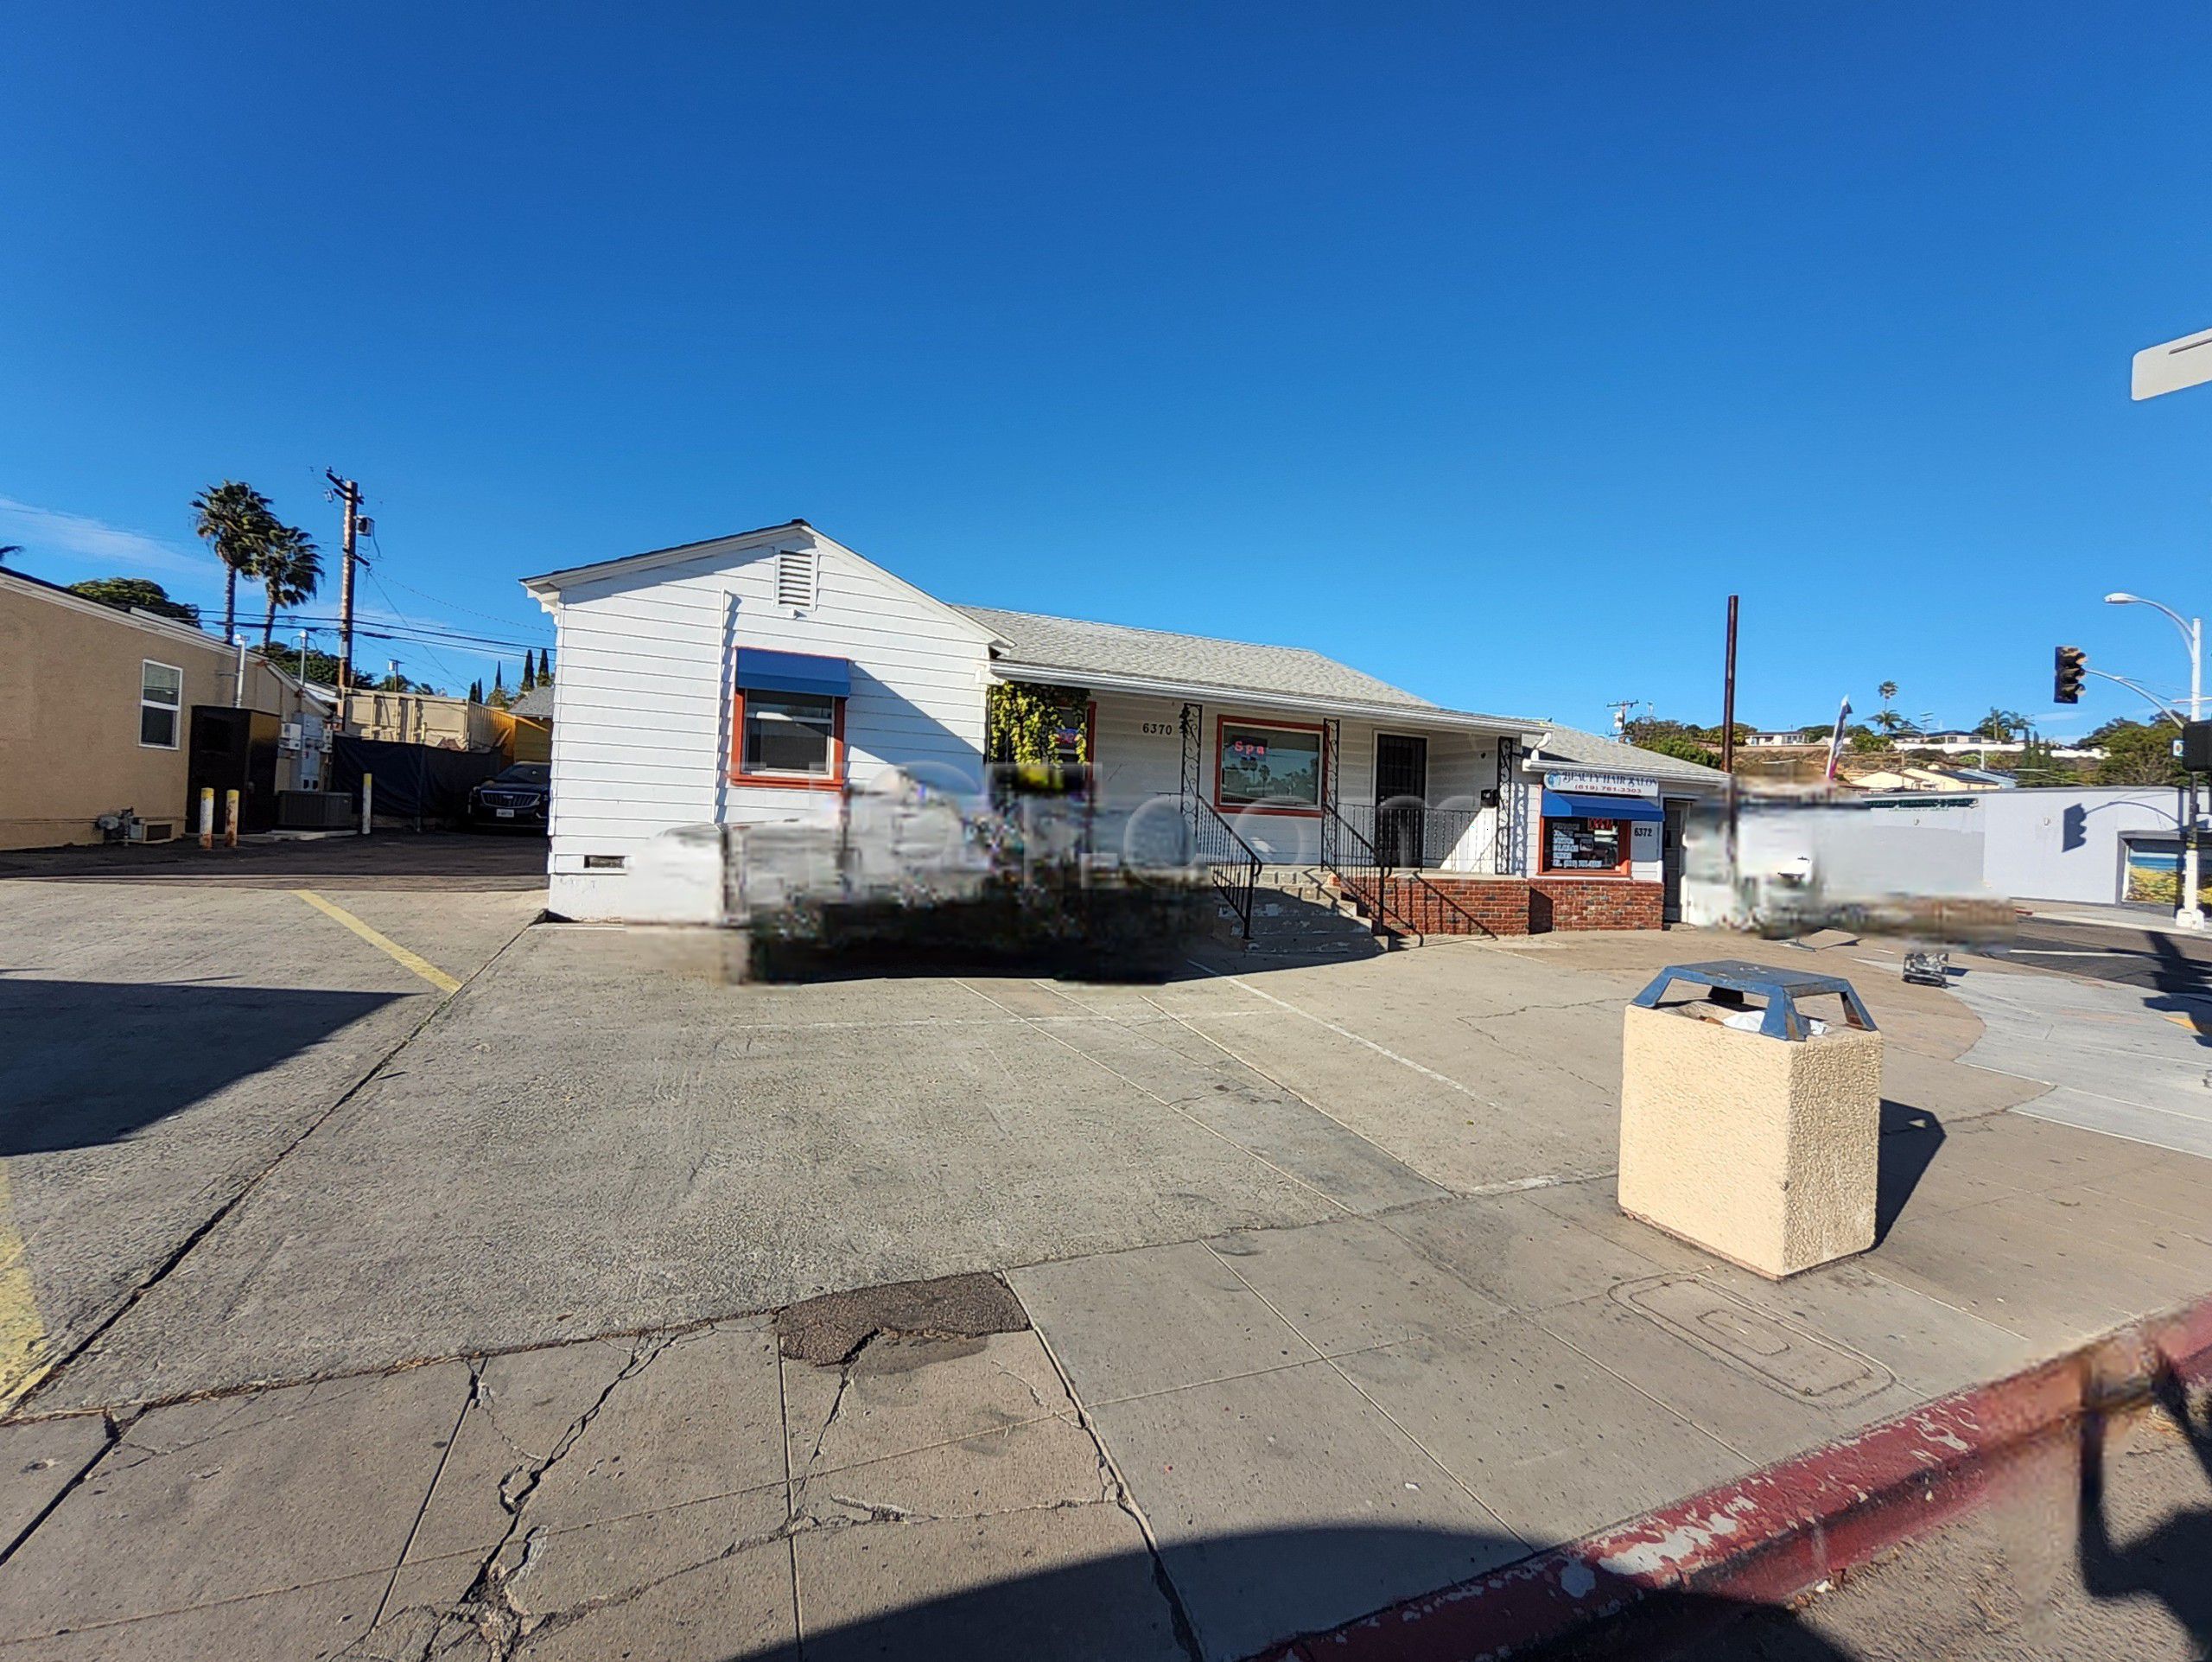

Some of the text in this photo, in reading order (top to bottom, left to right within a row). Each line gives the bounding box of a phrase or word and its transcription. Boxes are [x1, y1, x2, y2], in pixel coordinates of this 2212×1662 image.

[1141, 723, 1173, 735] 6370
[1234, 740, 1265, 756] Spa
[1603, 774, 1626, 785] HAIR
[1627, 776, 1658, 787] SALON
[1634, 827, 1653, 837] 6372
